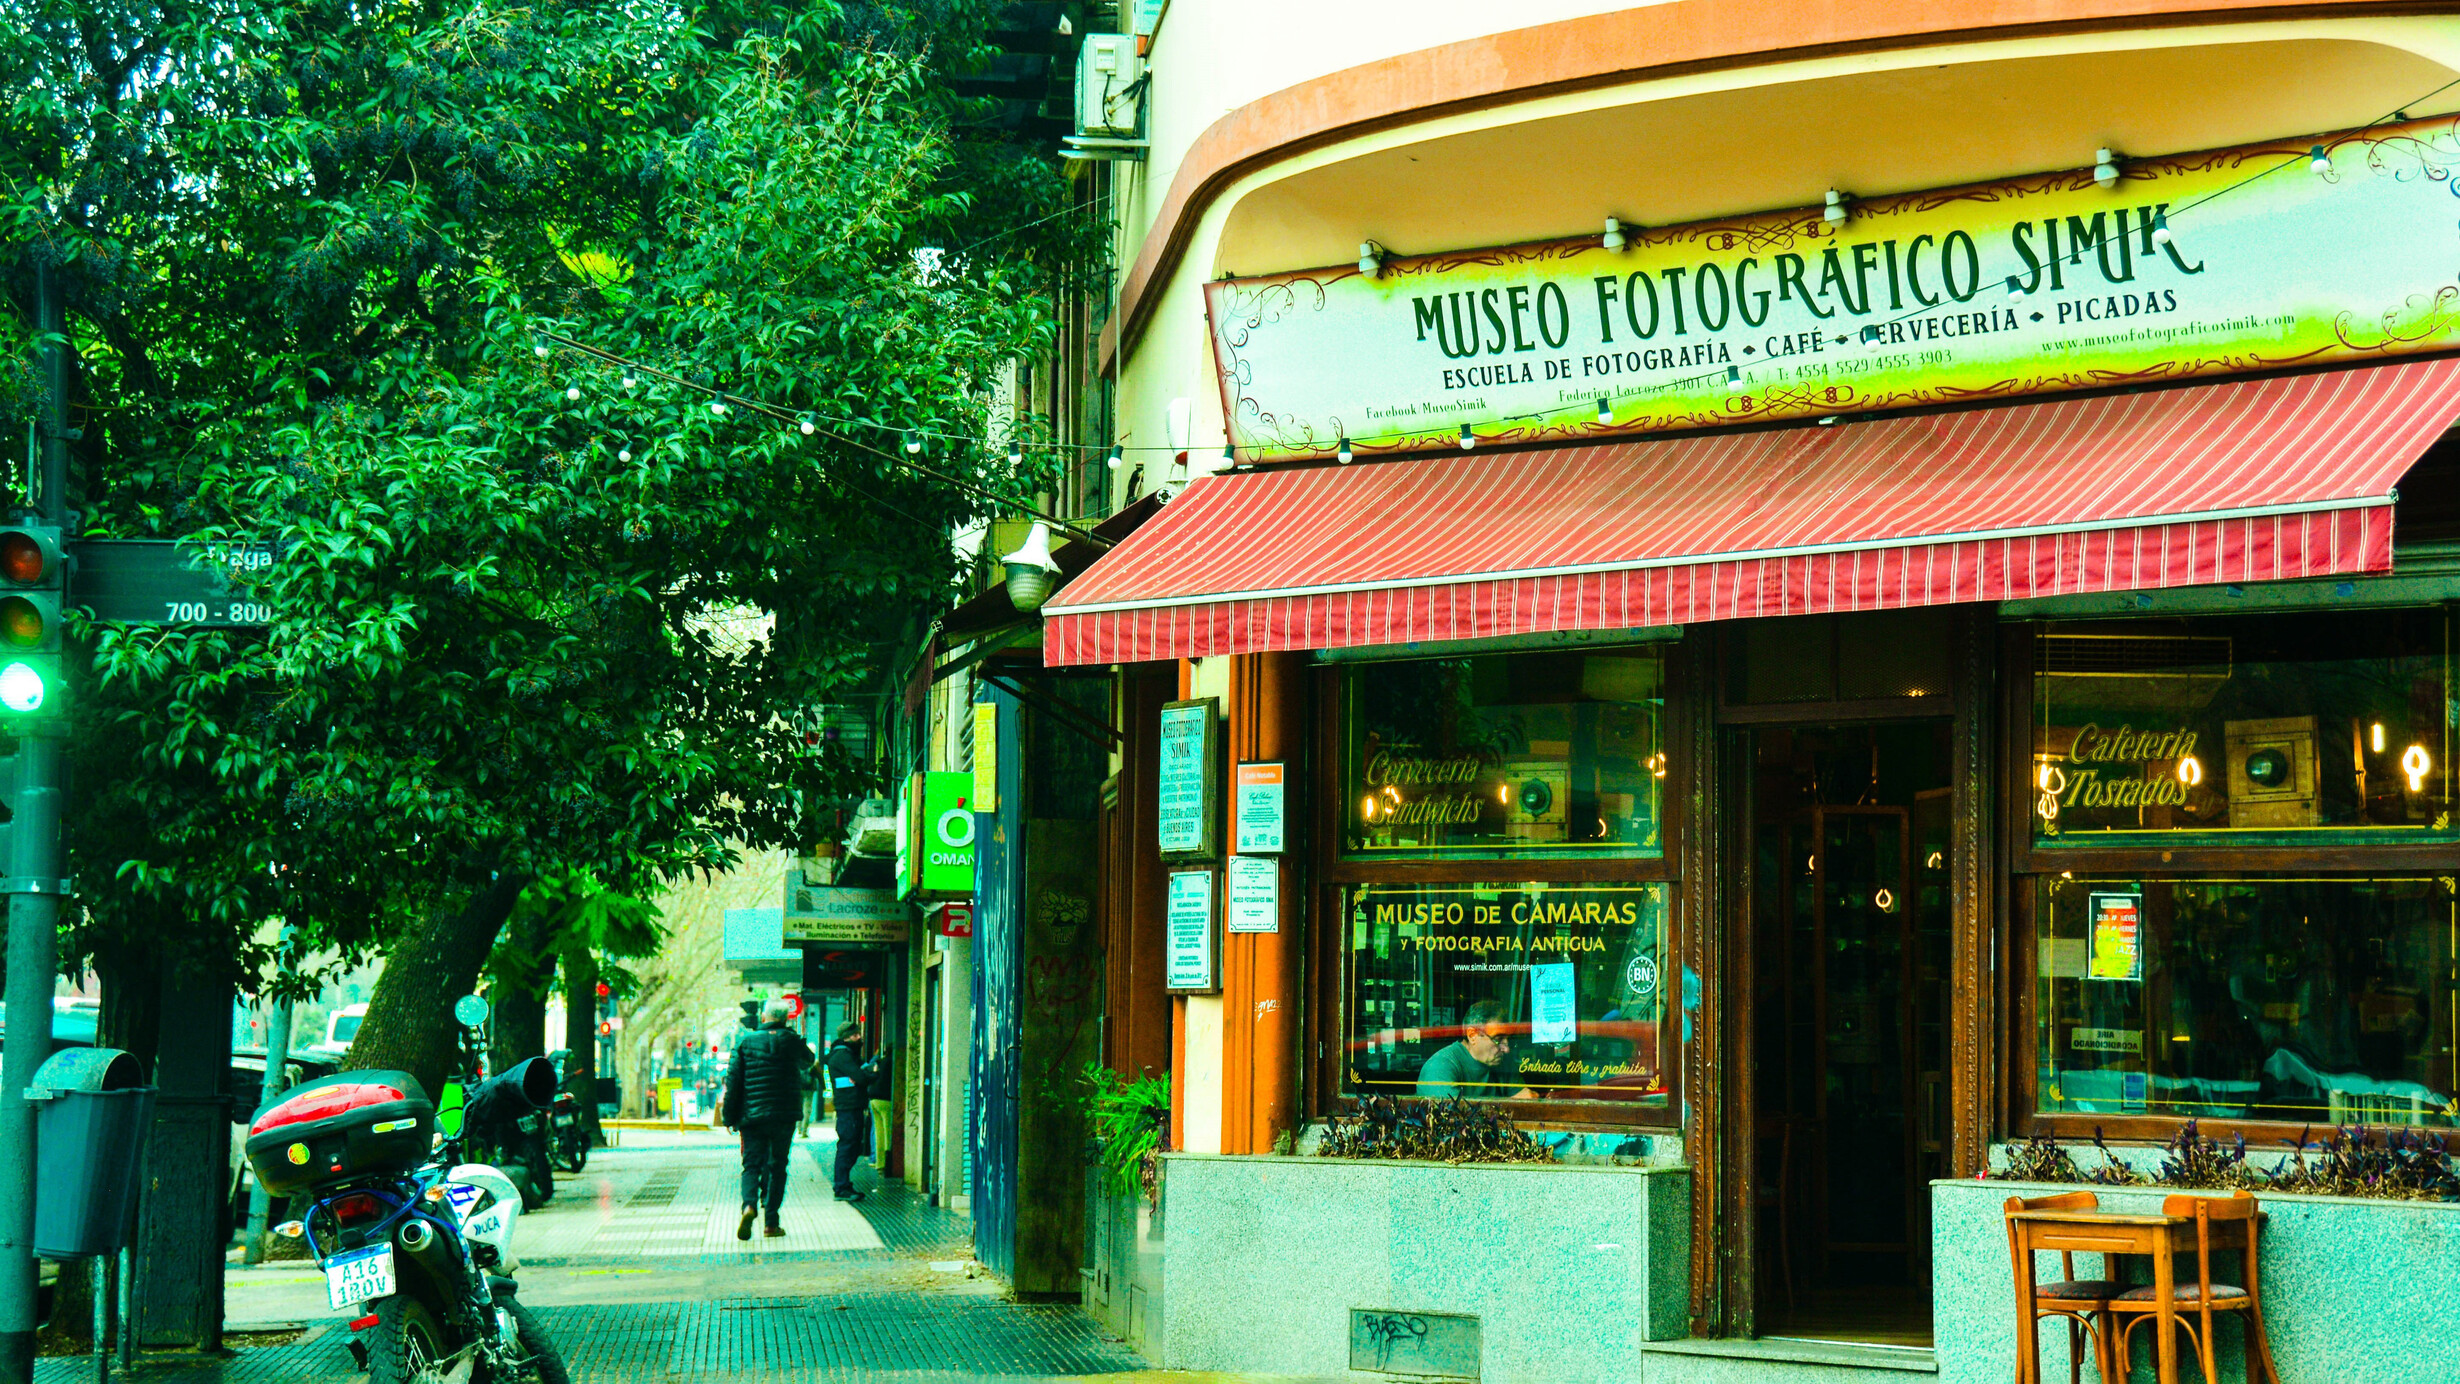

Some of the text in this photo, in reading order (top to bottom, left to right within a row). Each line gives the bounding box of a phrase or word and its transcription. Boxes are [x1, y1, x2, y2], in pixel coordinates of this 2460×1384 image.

[1412, 203, 2205, 359] MUSEO FOTOGRÁFICO SIMIK
[1443, 362, 1534, 389] ESCUELA
[1544, 358, 1572, 381] DE
[1583, 338, 1732, 377] FOTOGRAFÍA
[1765, 326, 1824, 358] CAFÉ
[2057, 289, 2177, 324] PICADAS
[2041, 314, 2295, 352] www.museofotograficosimik.com
[1559, 386, 1611, 402] Federico
[1616, 384, 1665, 398] Lacroze
[1707, 371, 1758, 389] C.A..A.
[1366, 397, 1487, 419] Facebook/MuseoSimik
[165, 602, 207, 622] 700
[229, 602, 272, 622] 800
[2069, 722, 2199, 764] Cafeteria
[2063, 769, 2192, 808] Tostados
[829, 903, 879, 914] Lacroze
[1376, 902, 1637, 925] MUSEO DE CAMARAS
[1416, 936, 1524, 951] FOTOGRAFIA
[1530, 936, 1606, 952] ANTIGUA
[1634, 967, 1651, 981] BN
[1518, 1056, 1647, 1078] Entrada libre y gratuita
[343, 1257, 379, 1283] A16
